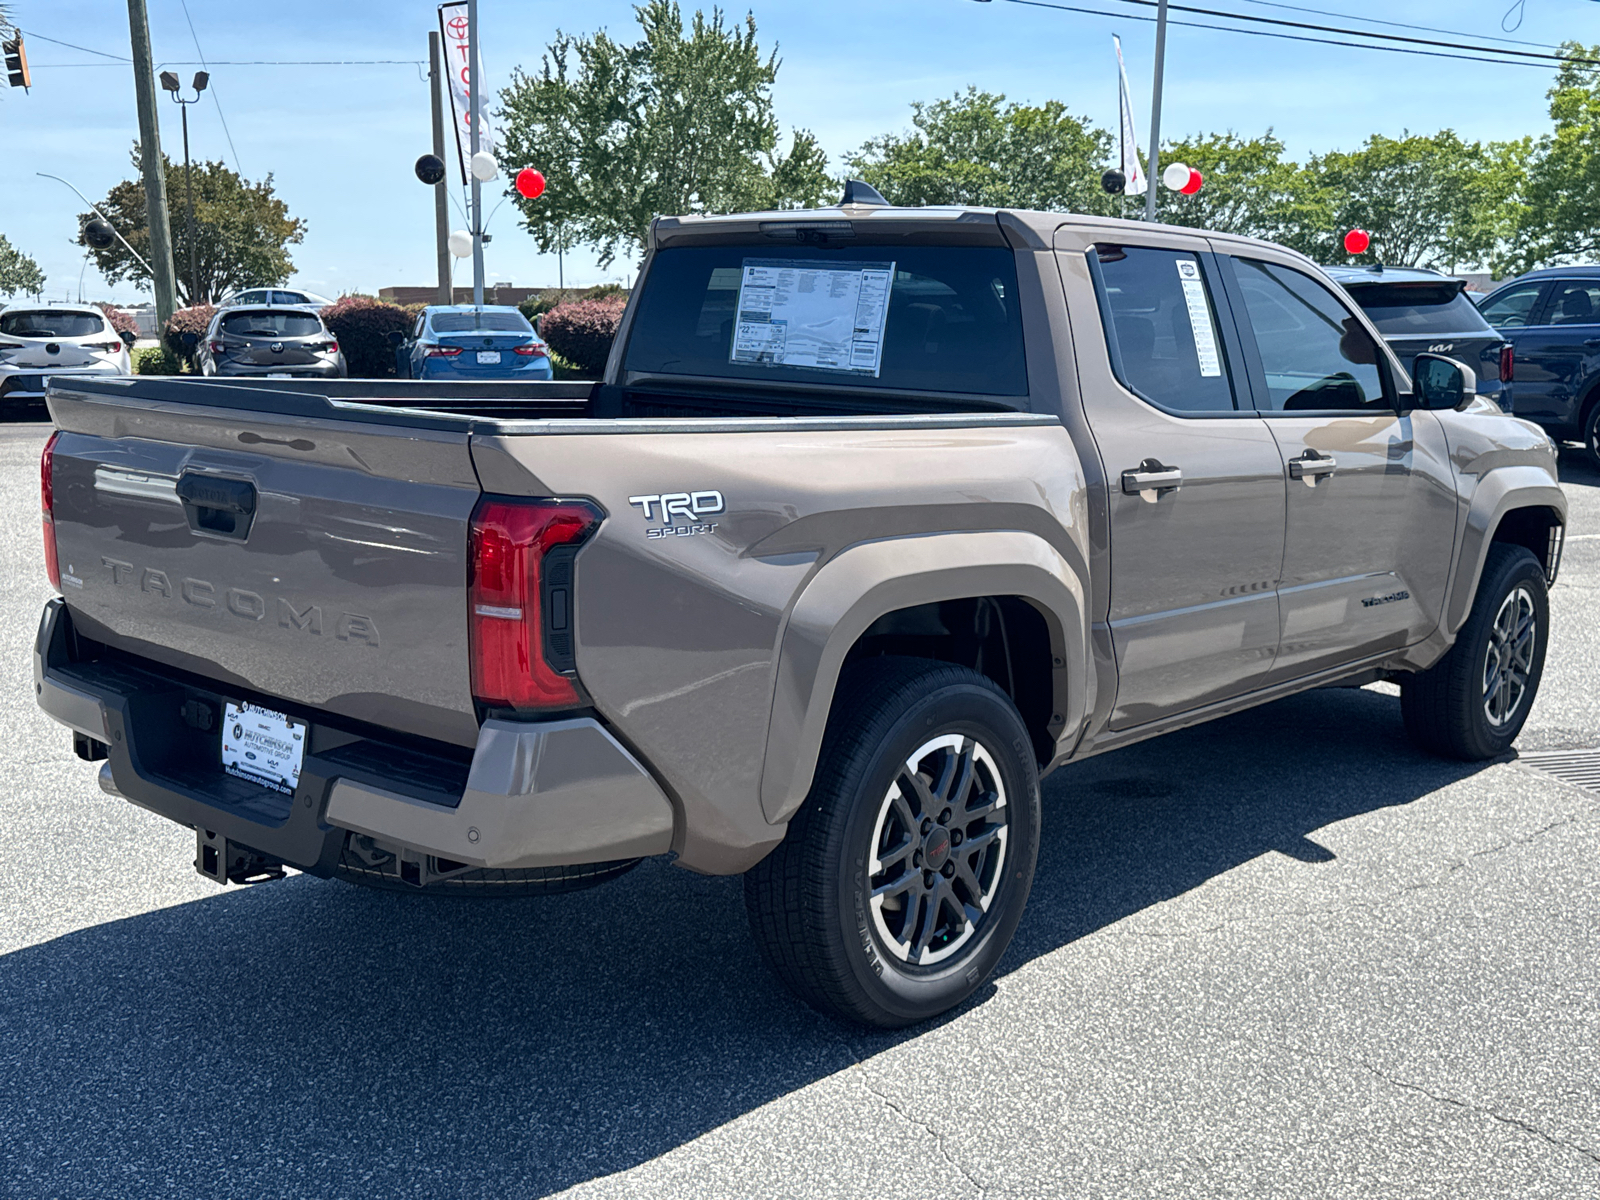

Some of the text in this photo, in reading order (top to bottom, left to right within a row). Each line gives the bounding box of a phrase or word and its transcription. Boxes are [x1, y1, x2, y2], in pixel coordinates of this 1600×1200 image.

[1428, 343, 1454, 353] KIA
[627, 489, 724, 524] TRD
[646, 523, 719, 540] SPORT
[101, 556, 380, 648] TACOMA
[249, 703, 288, 722] HUTCHINSON
[244, 729, 294, 754] HUTCHINSON
[244, 741, 274, 756] AUTOMOTIVE
[274, 750, 291, 761] GROUP
[854, 848, 884, 977] GENERAL
